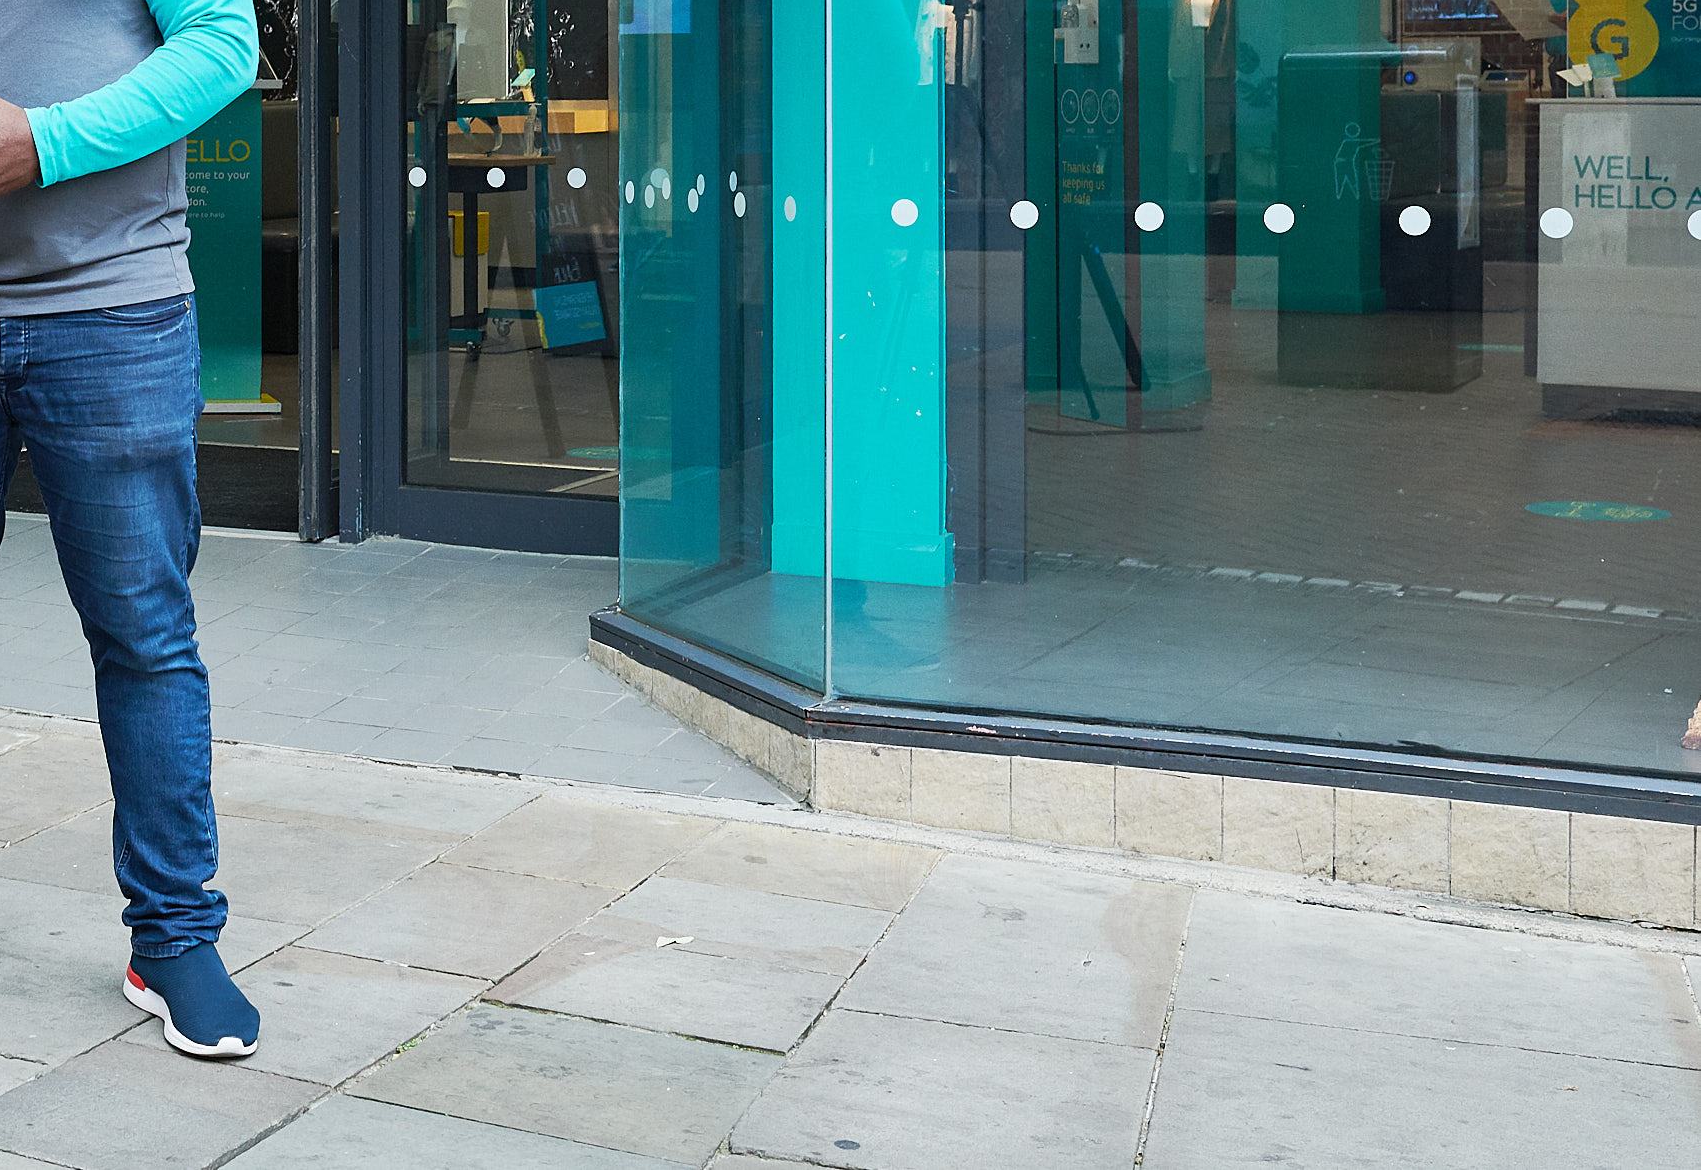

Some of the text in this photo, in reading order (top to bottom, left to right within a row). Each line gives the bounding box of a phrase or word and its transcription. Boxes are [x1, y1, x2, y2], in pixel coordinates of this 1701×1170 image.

[1672, 15, 1701, 31] FO
[186, 140, 250, 162] ELLO
[1062, 160, 1104, 174] Thanks for
[1574, 154, 1669, 183] WELL,
[227, 172, 250, 181] your
[1062, 178, 1105, 192] keeping us
[1062, 192, 1091, 206] all safe
[1575, 184, 1677, 209] HELLO
